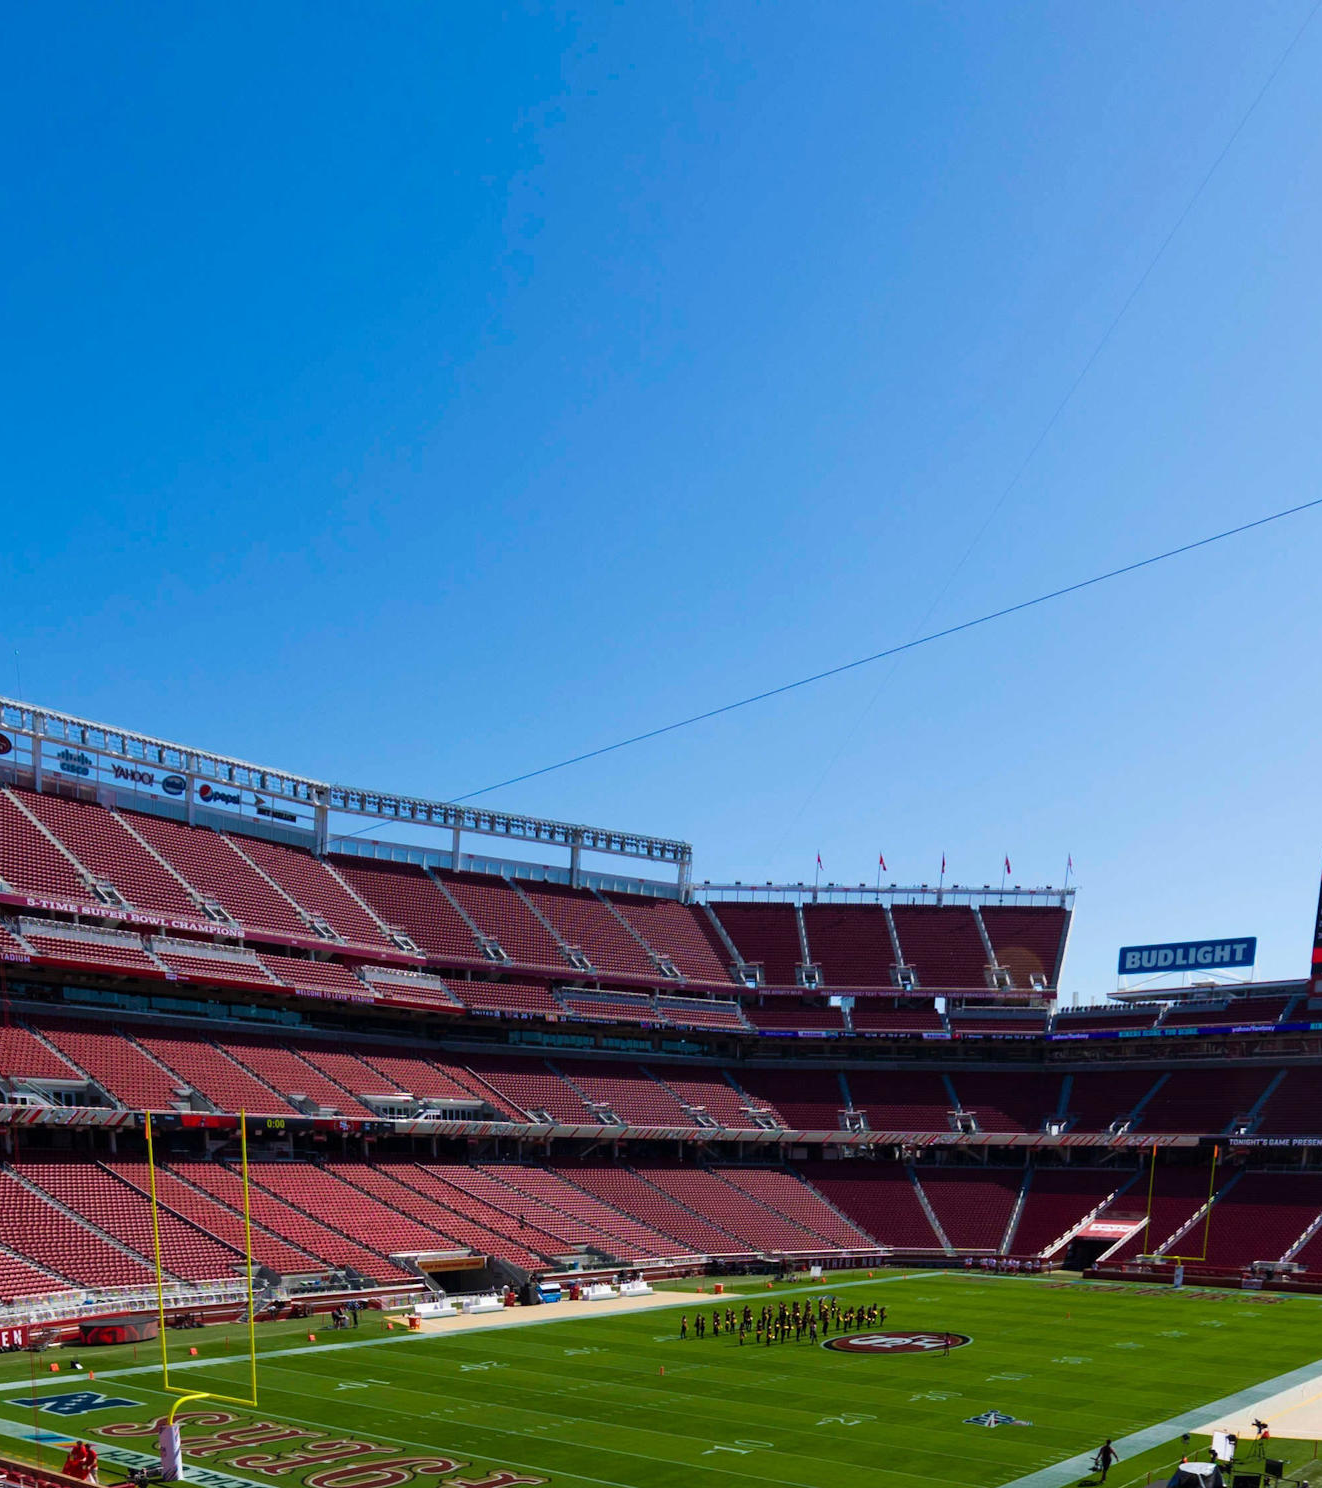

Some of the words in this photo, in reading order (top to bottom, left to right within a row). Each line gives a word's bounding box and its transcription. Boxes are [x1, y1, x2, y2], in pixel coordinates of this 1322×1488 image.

[111, 763, 154, 787] YAHOO!
[212, 790, 240, 805] pepsi
[27, 897, 78, 913] 5-TIME
[81, 905, 127, 921] SUPER
[130, 912, 169, 927] BOWL
[171, 919, 246, 939] CHAMPIONS
[1126, 949, 1174, 970] BUD
[1176, 943, 1248, 966] LIGHT
[266, 1118, 285, 1130] 0:00
[1229, 1138, 1268, 1146] TONIGHT'S
[1269, 1138, 1291, 1146] GAME
